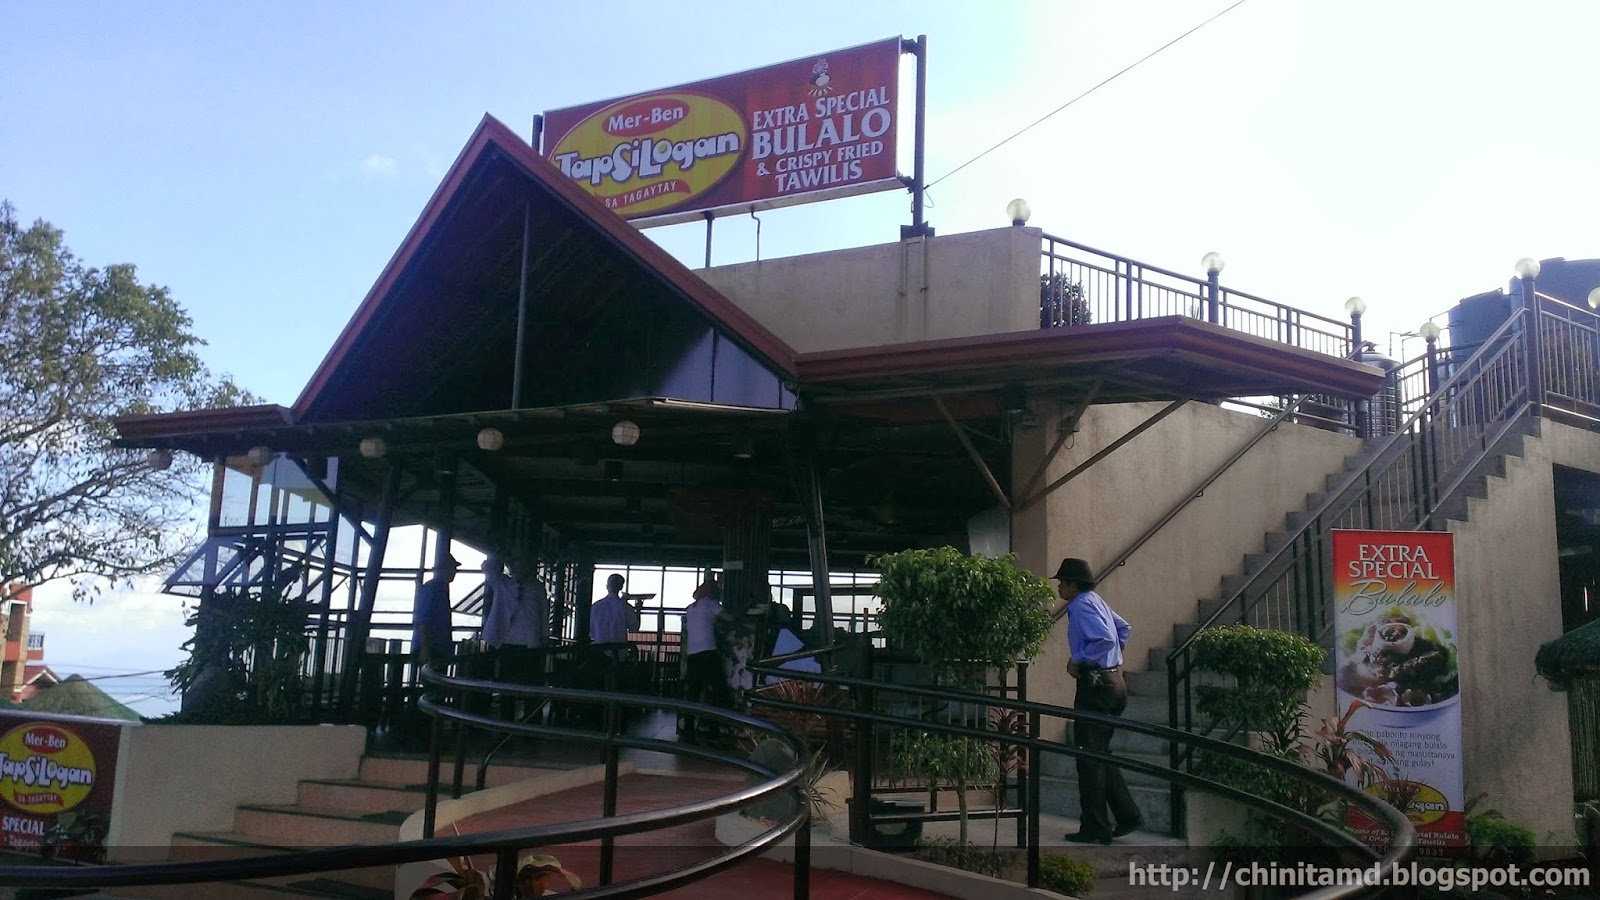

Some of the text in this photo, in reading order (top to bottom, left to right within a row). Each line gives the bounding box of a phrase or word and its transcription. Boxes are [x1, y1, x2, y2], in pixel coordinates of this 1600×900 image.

[608, 106, 683, 132] Mer-Ben
[753, 86, 890, 131] EXTRA SPECIAL
[752, 107, 891, 160] BULALO
[555, 132, 739, 184] TapSiLogan
[756, 140, 884, 176] & CRISPY FRIED
[774, 160, 863, 192] TAWILIS
[605, 180, 677, 208] SA TAGAYTAY
[1358, 544, 1429, 562] EXTRA
[1348, 561, 1439, 579] SPECIAL
[1340, 579, 1447, 615] Bulalo
[25, 732, 66, 748] Mer-Ben
[1424, 741, 1448, 750] bulalo
[2, 815, 45, 835] SPECIAL
